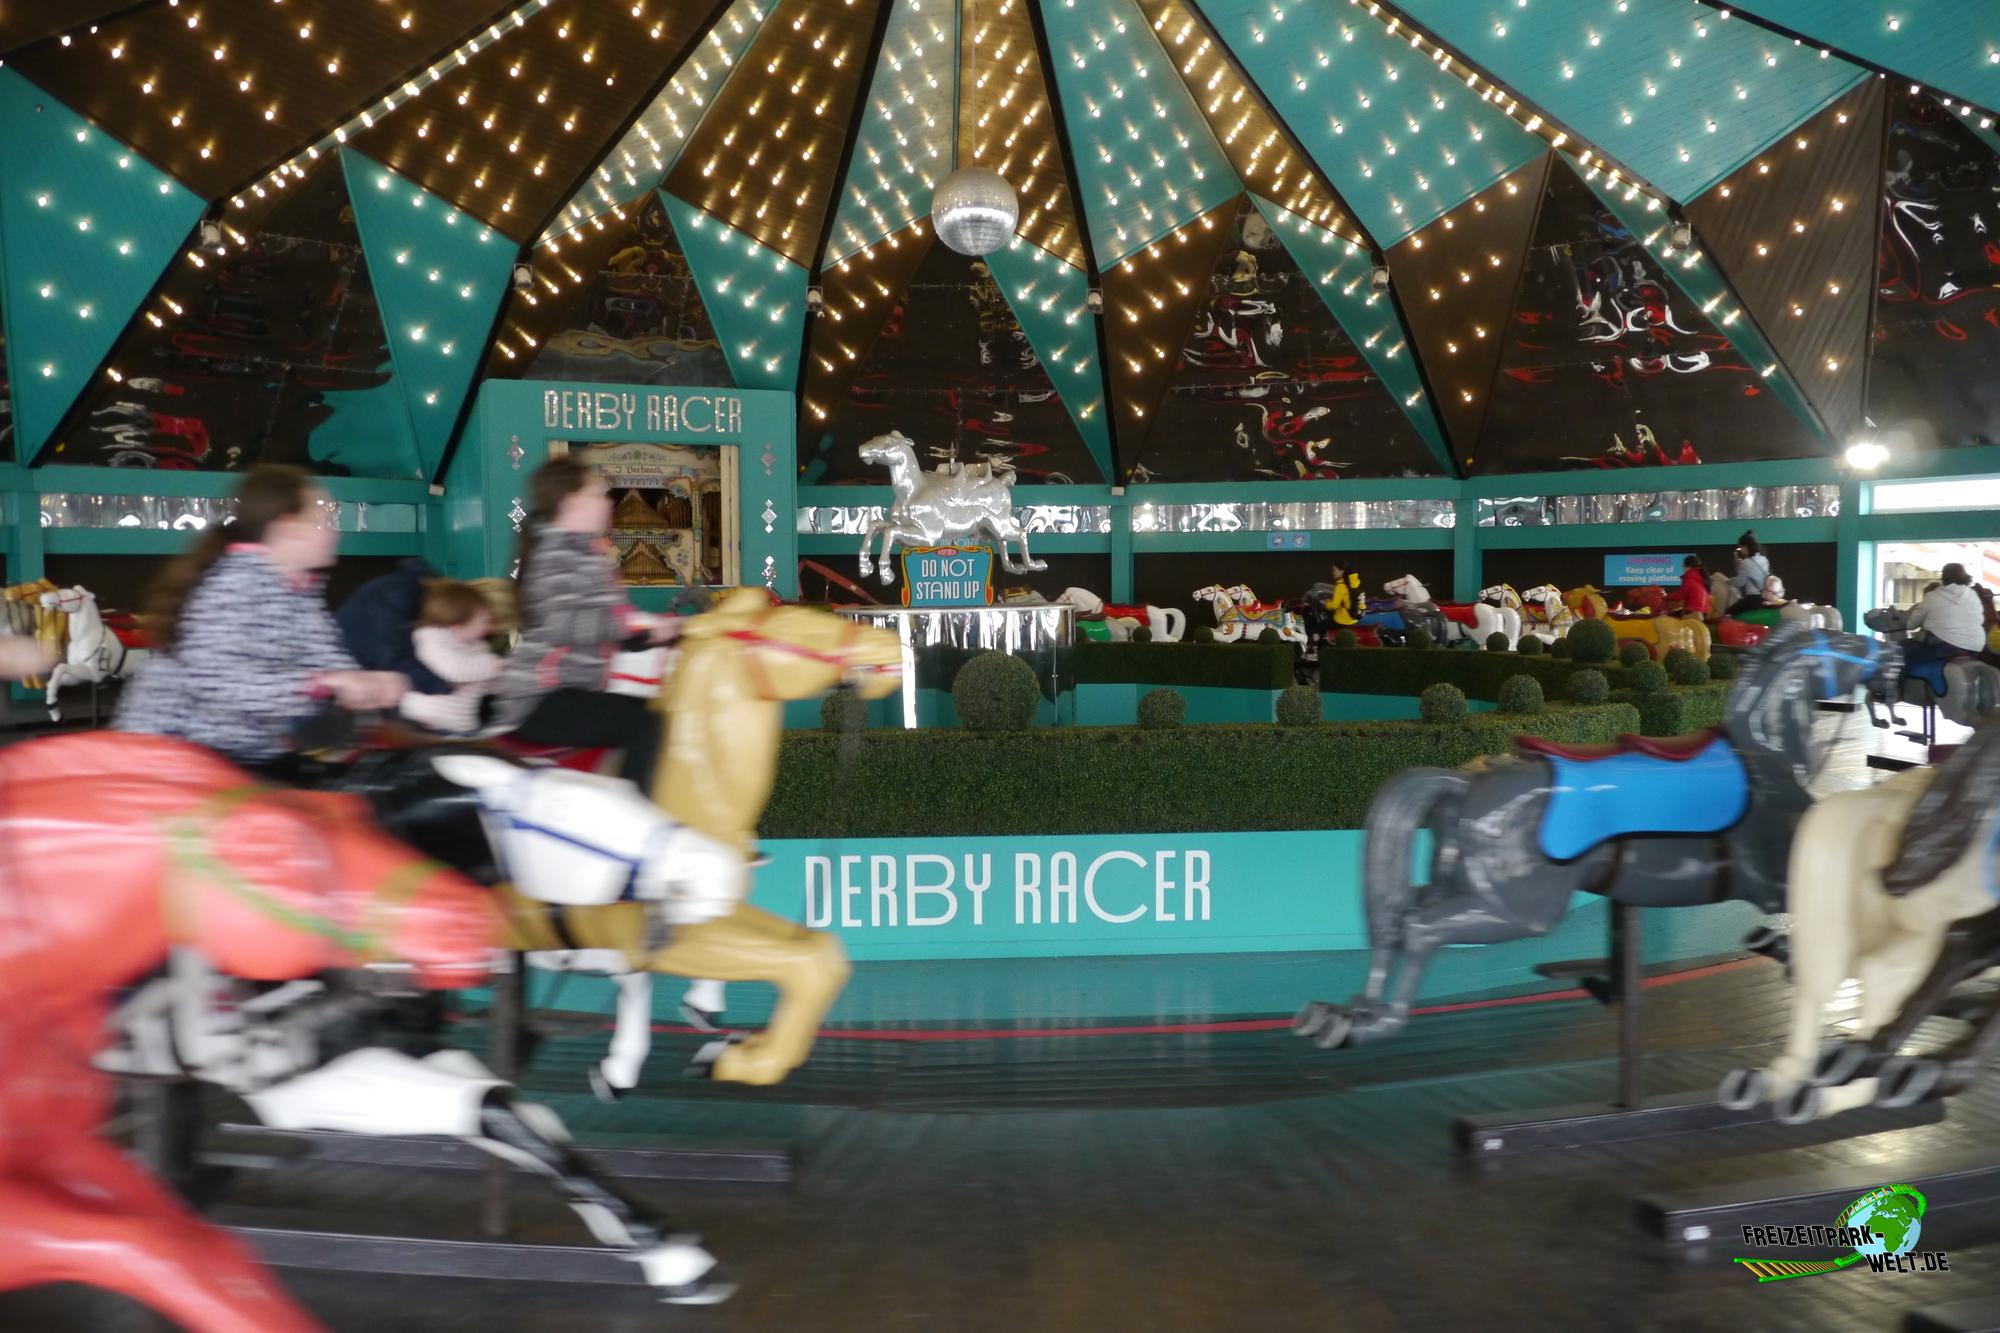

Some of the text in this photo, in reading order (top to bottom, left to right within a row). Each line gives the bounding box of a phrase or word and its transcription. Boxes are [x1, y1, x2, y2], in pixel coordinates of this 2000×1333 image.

[544, 390, 741, 433] DERBY RACER
[922, 559, 975, 577] DO NOT
[1625, 565, 1674, 575] Keep clear of
[1619, 575, 1647, 583] moving
[916, 581, 979, 600] STAND UP
[805, 850, 1211, 928] DERBY RACER
